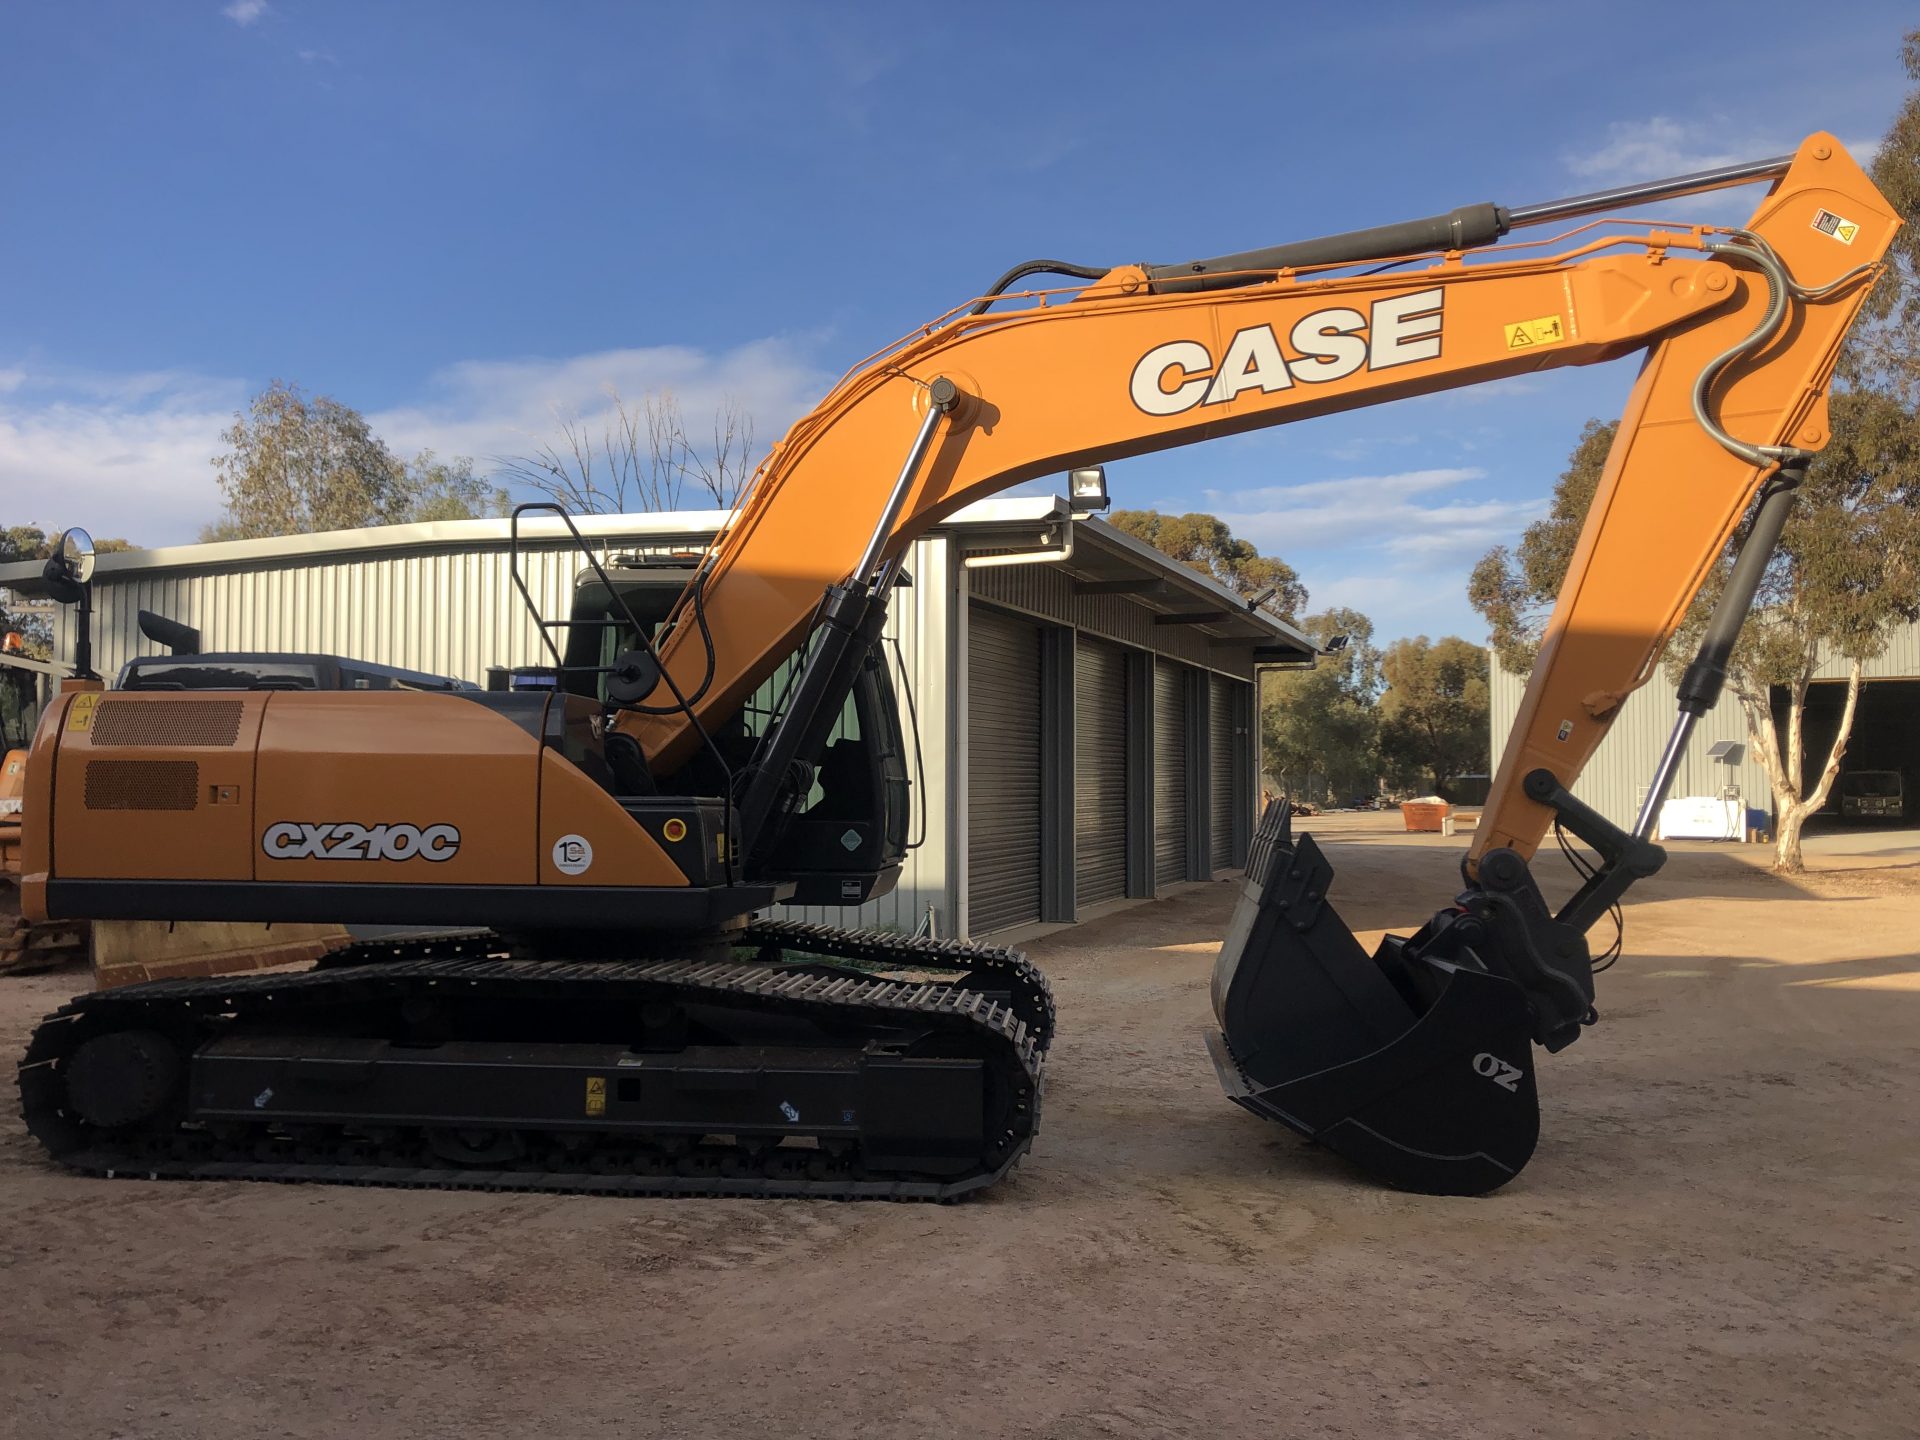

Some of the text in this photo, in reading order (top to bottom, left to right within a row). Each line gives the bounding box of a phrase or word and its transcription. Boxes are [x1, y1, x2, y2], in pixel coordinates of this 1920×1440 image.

[1129, 287, 1445, 416] CASE
[262, 821, 461, 862] CX210C
[1473, 1053, 1523, 1092] OZ
